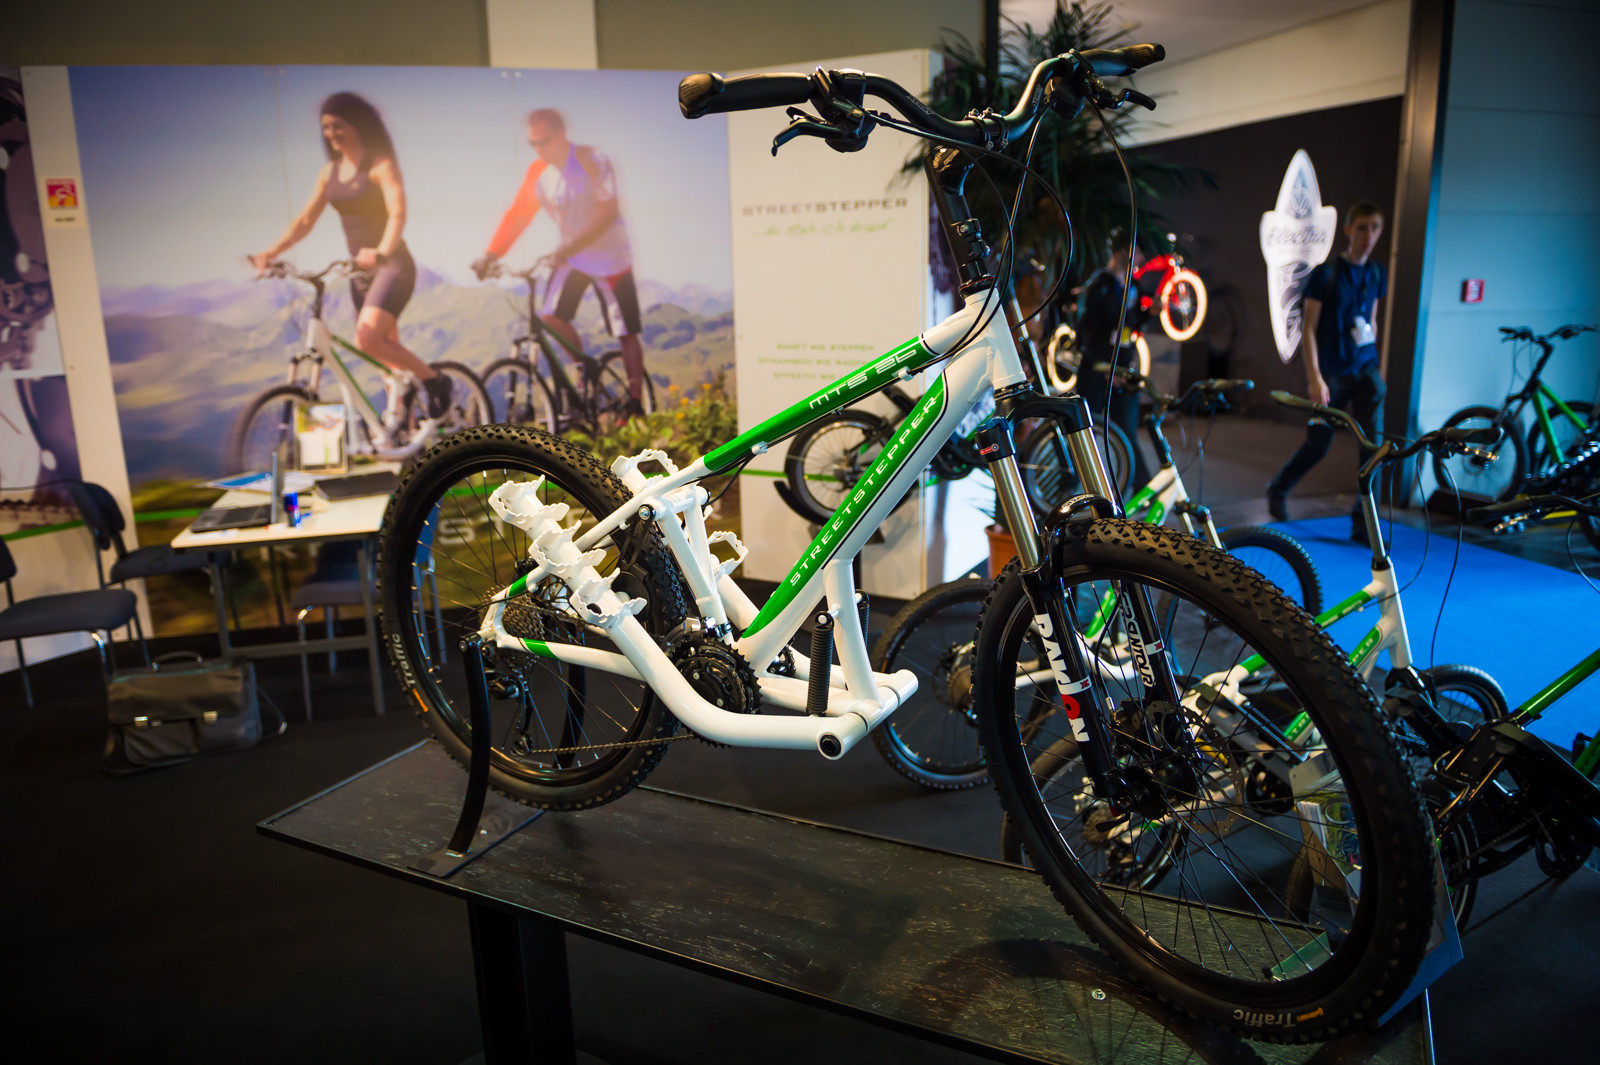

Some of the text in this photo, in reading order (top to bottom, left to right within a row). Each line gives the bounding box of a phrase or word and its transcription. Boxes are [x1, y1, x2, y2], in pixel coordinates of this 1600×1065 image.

[742, 198, 908, 217] STREETSTEPPER
[789, 395, 938, 588] STREETSTEPPER
[391, 632, 417, 689] Traffic
[1232, 1008, 1296, 1029] Traffic
